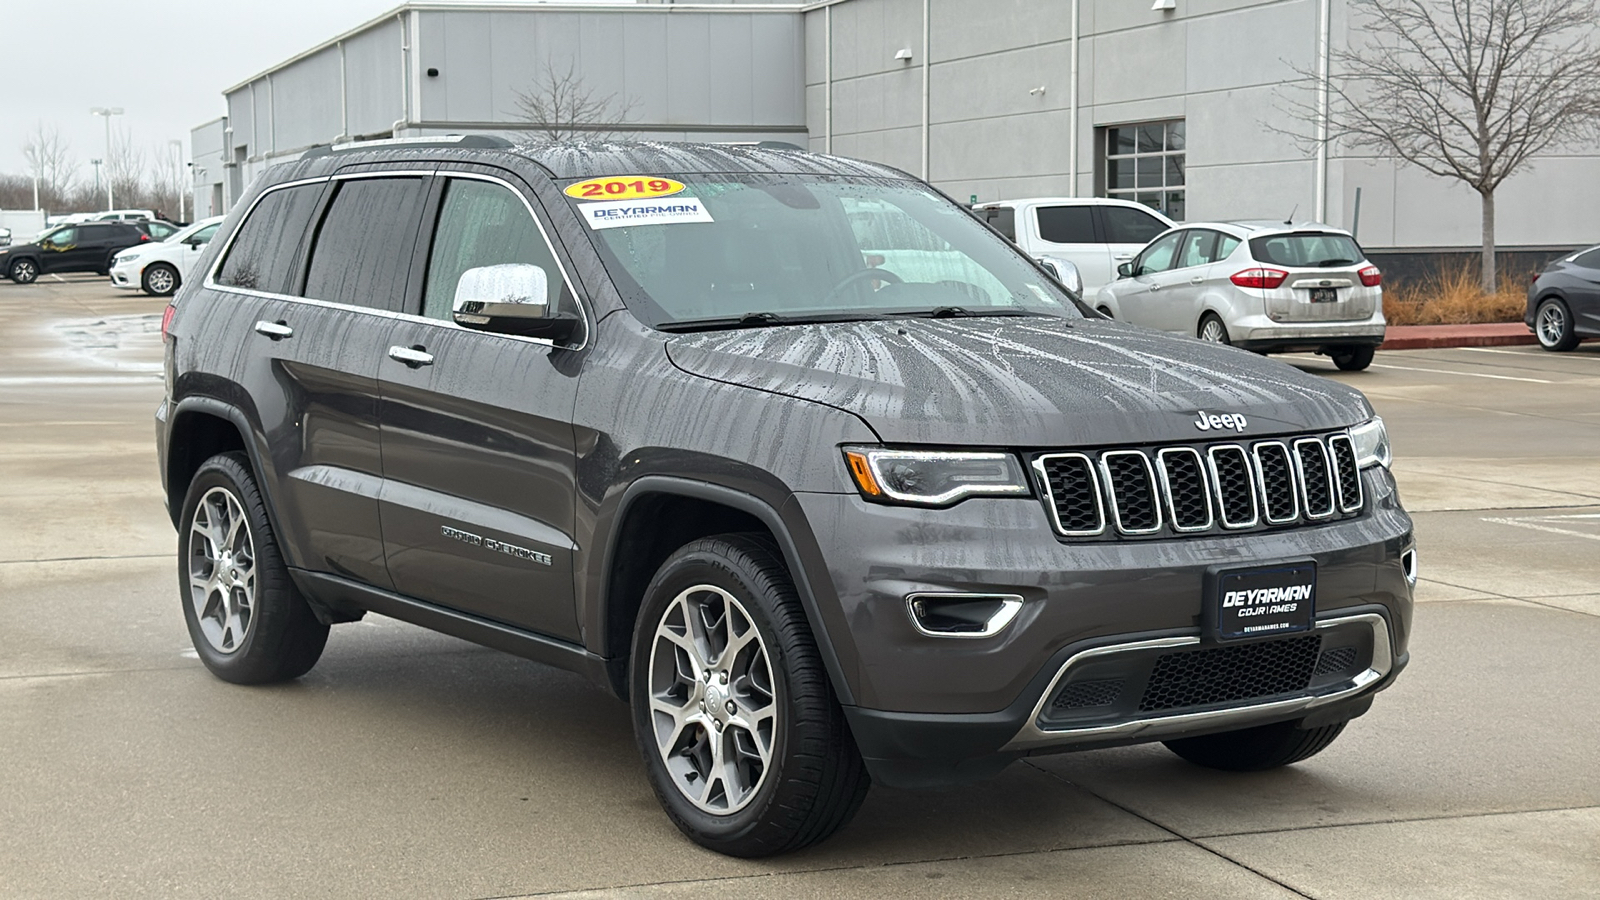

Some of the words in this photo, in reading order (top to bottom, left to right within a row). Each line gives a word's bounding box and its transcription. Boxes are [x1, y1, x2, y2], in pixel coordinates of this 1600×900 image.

[581, 180, 671, 197] 2019
[593, 205, 698, 218] DEYARMAN
[604, 213, 648, 221] CERTIFIED
[1194, 410, 1248, 433] Jeep
[441, 525, 483, 546] GRAND
[484, 538, 553, 566] CHEROKEE
[1223, 584, 1312, 608] DEYARMAN
[1238, 606, 1265, 618] CDJR
[1269, 603, 1297, 614] AMES
